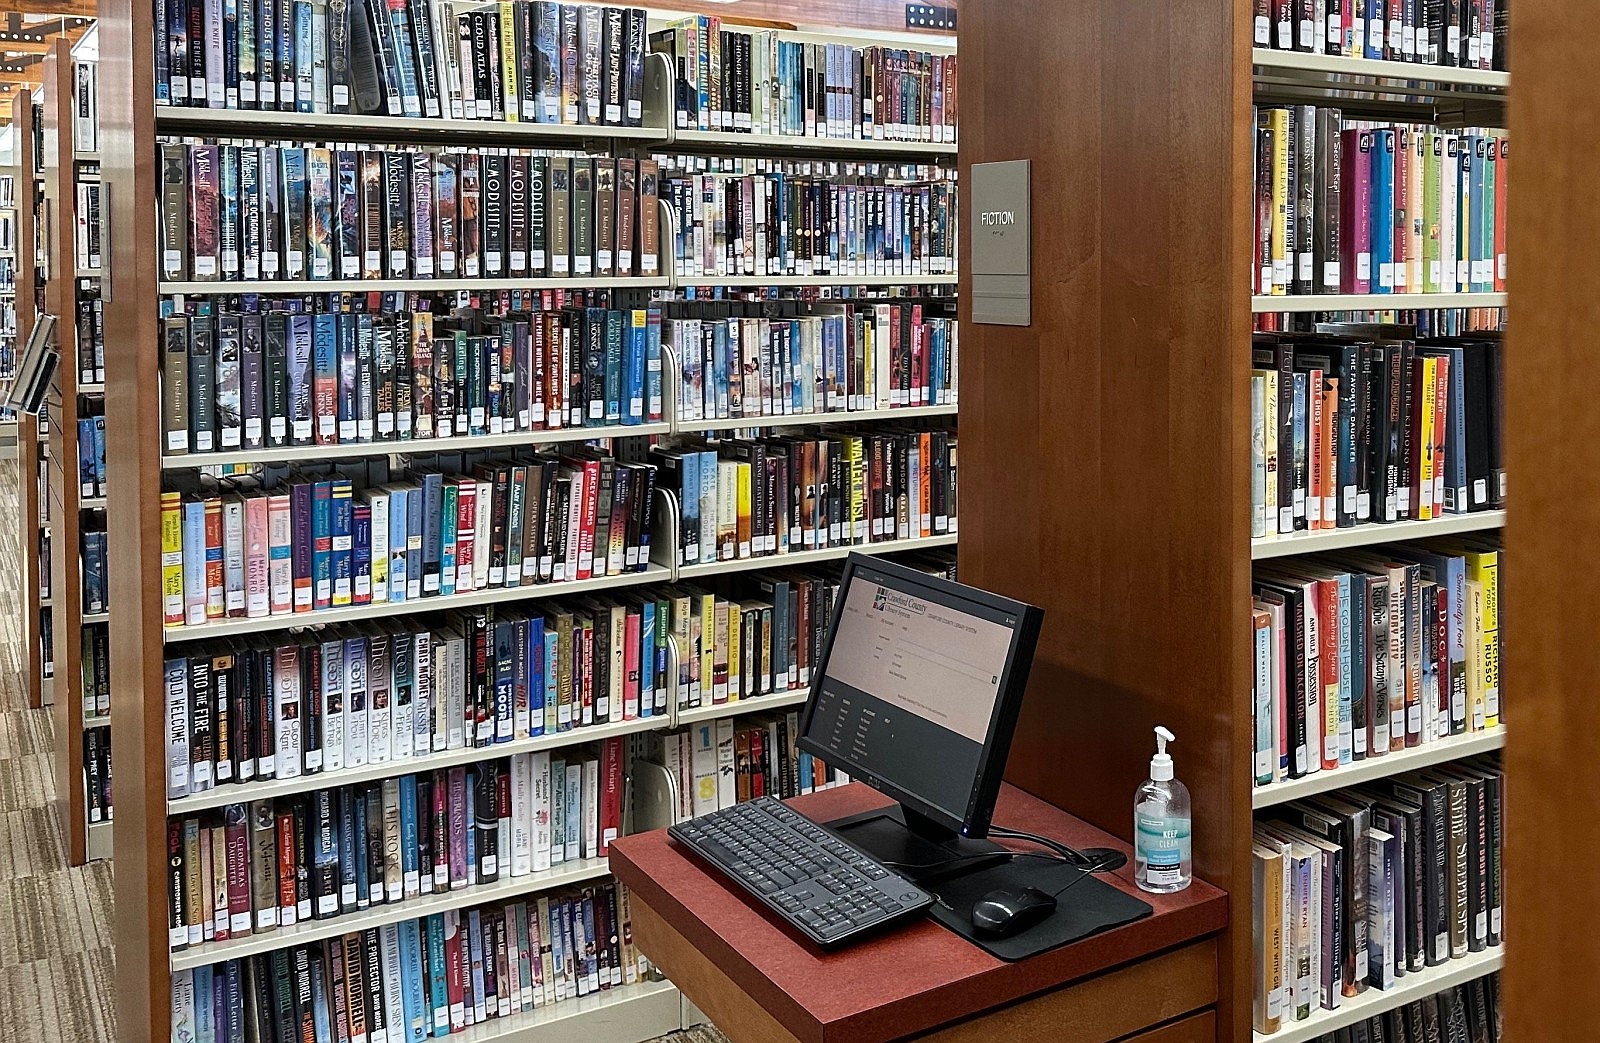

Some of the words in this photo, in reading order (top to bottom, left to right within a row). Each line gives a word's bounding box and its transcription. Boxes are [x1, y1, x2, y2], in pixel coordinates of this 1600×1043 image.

[475, 16, 483, 49] CLOUD
[476, 52, 485, 79] ATLAS
[505, 48, 513, 63] HOME
[981, 211, 1015, 226] FICTION
[458, 340, 466, 370] darling
[362, 373, 371, 396] ELYSIUM
[852, 440, 863, 485] WALTER
[587, 497, 595, 526] ABRAMS
[1296, 601, 1304, 650] VANISHED
[1391, 592, 1399, 634] VICTORY
[1341, 610, 1350, 652] GOLDEN
[418, 638, 428, 664] CHRIS
[1296, 653, 1304, 668] ON
[170, 669, 184, 695] COLD
[194, 664, 209, 688] INTO
[419, 666, 429, 700] MOONEY
[1342, 656, 1350, 695] HOUSE
[196, 690, 208, 706] THE
[498, 685, 506, 720] MOOR
[1376, 687, 1388, 719] Verses
[171, 698, 185, 745] WELCOME
[194, 708, 209, 734] FIRE
[320, 791, 329, 818] RICHARD
[386, 803, 397, 832] THIS
[1451, 787, 1463, 839] SAFIRE
[322, 827, 330, 853] MORGAN
[1163, 829, 1178, 839] KEEP
[386, 836, 398, 871] ROCK
[1456, 844, 1467, 906] SLEEPER
[1457, 910, 1467, 935] SPY
[366, 930, 377, 945] THE
[295, 950, 308, 970] DAVID
[347, 938, 361, 973] DAVID
[368, 946, 380, 992] PROTECTOR
[183, 983, 192, 1006] Liane
[230, 983, 239, 1003] Fifth
[298, 971, 311, 1004] MORRELL
[349, 976, 364, 1025] MORRELL
[230, 1006, 239, 1030] Letter
